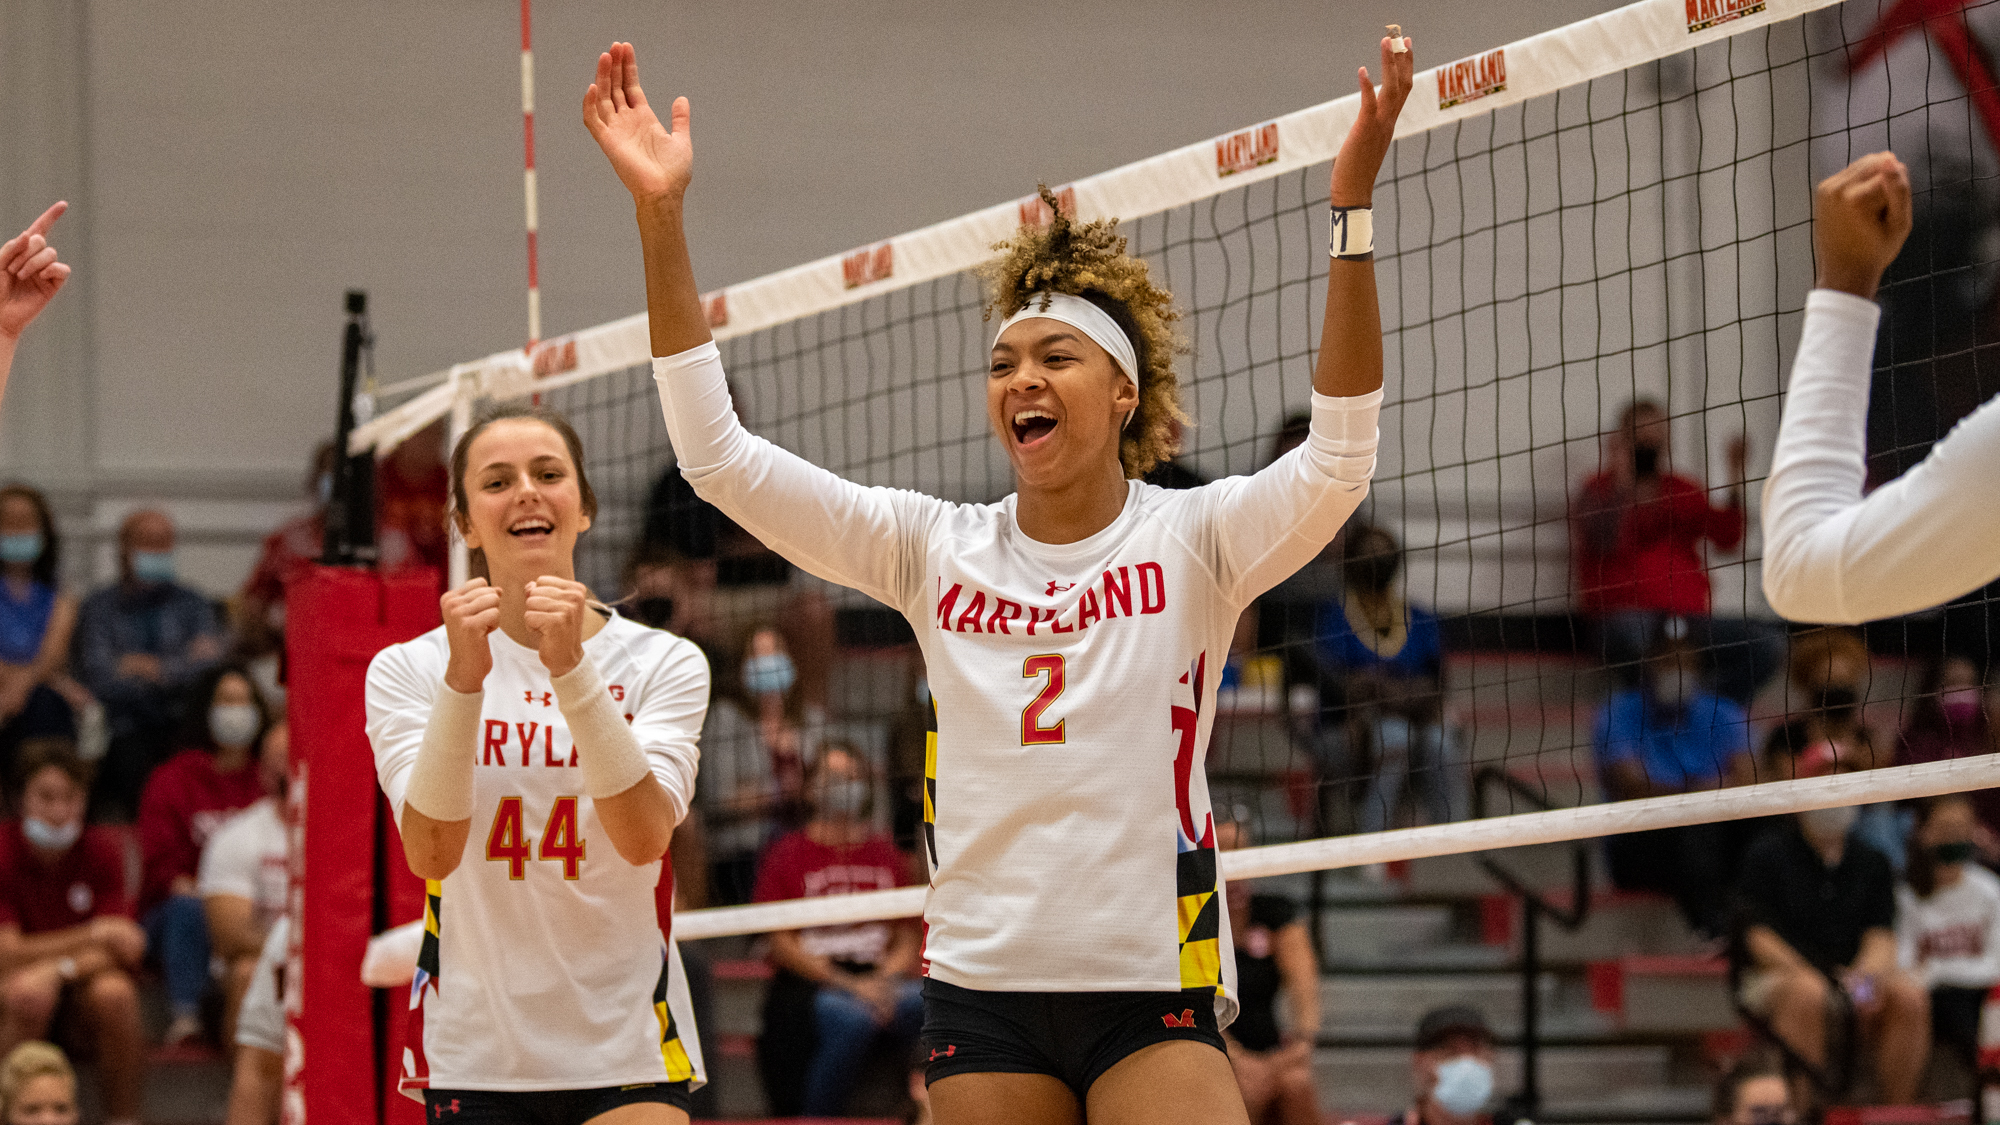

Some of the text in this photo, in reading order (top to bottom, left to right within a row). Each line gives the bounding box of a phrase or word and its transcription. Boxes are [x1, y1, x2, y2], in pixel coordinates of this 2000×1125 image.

[1436, 50, 1506, 99] MARYLAND
[1021, 653, 1066, 746] 2
[485, 796, 587, 881] 44
